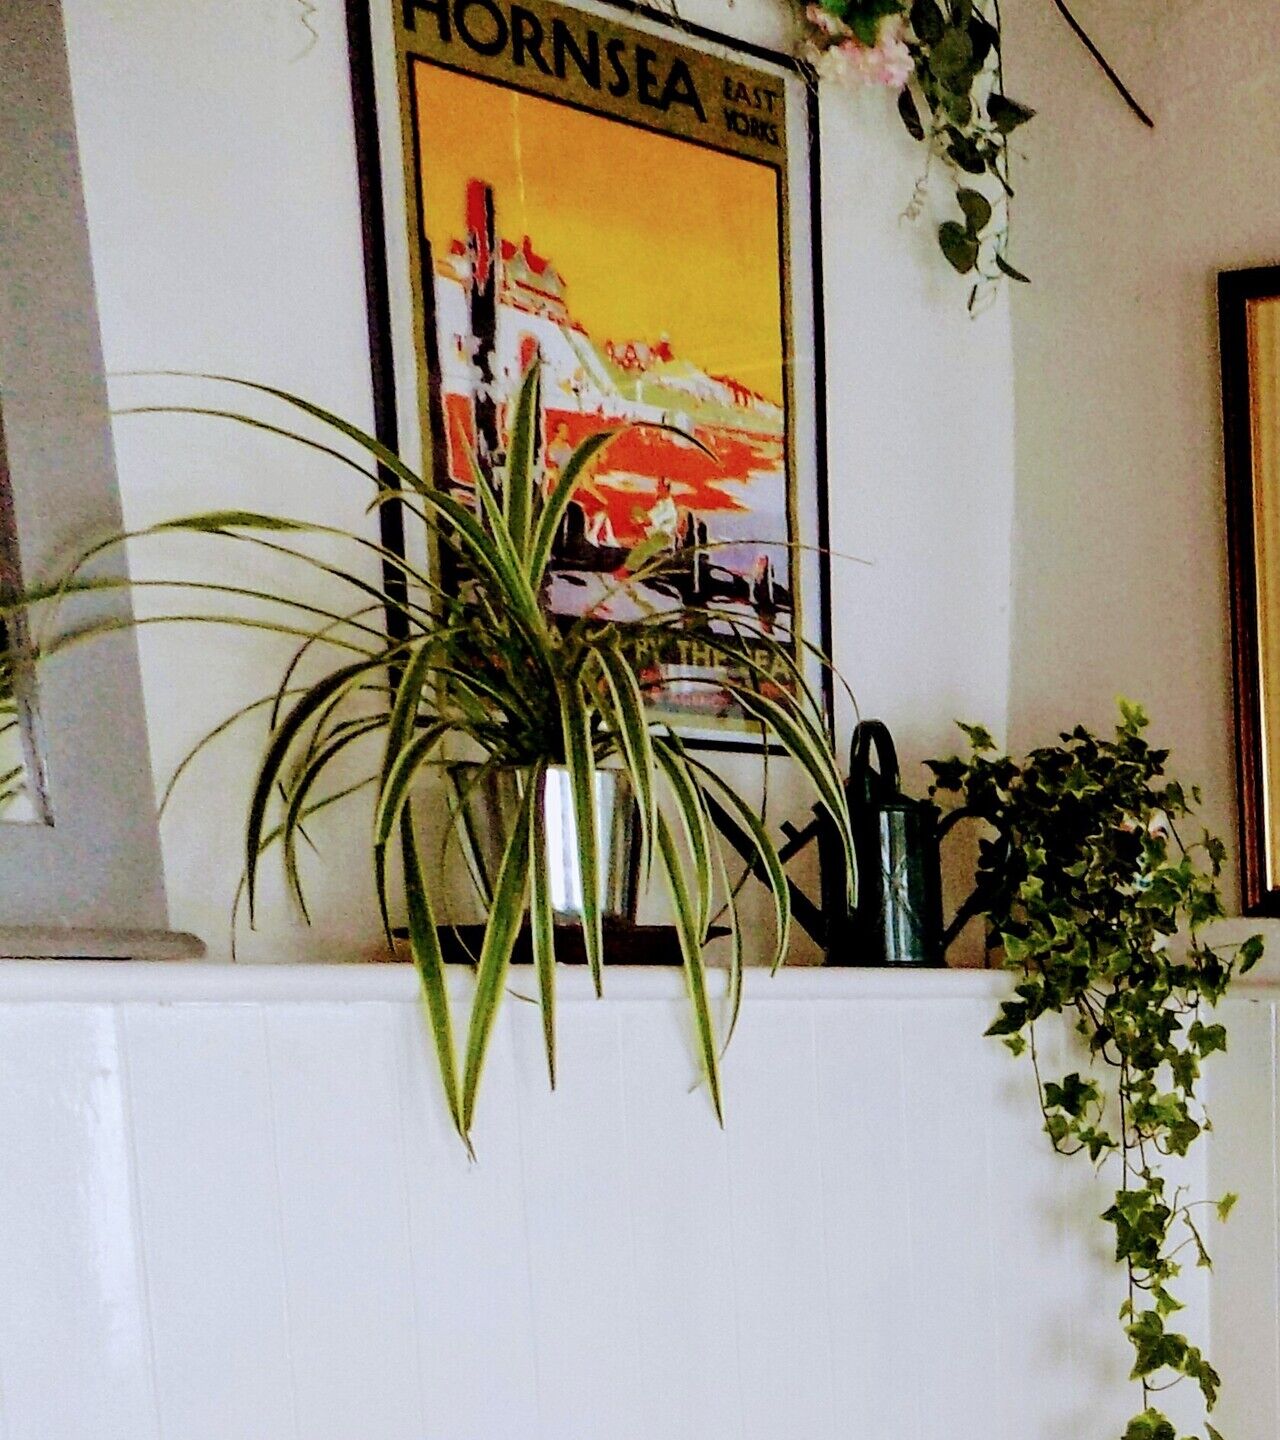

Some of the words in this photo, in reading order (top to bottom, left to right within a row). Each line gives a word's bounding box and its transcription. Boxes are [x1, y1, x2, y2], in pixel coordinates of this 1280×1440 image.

[403, 0, 708, 123] HORNSEA
[723, 77, 778, 112] EAST
[724, 107, 780, 147] YORKS
[676, 639, 727, 668] THE
